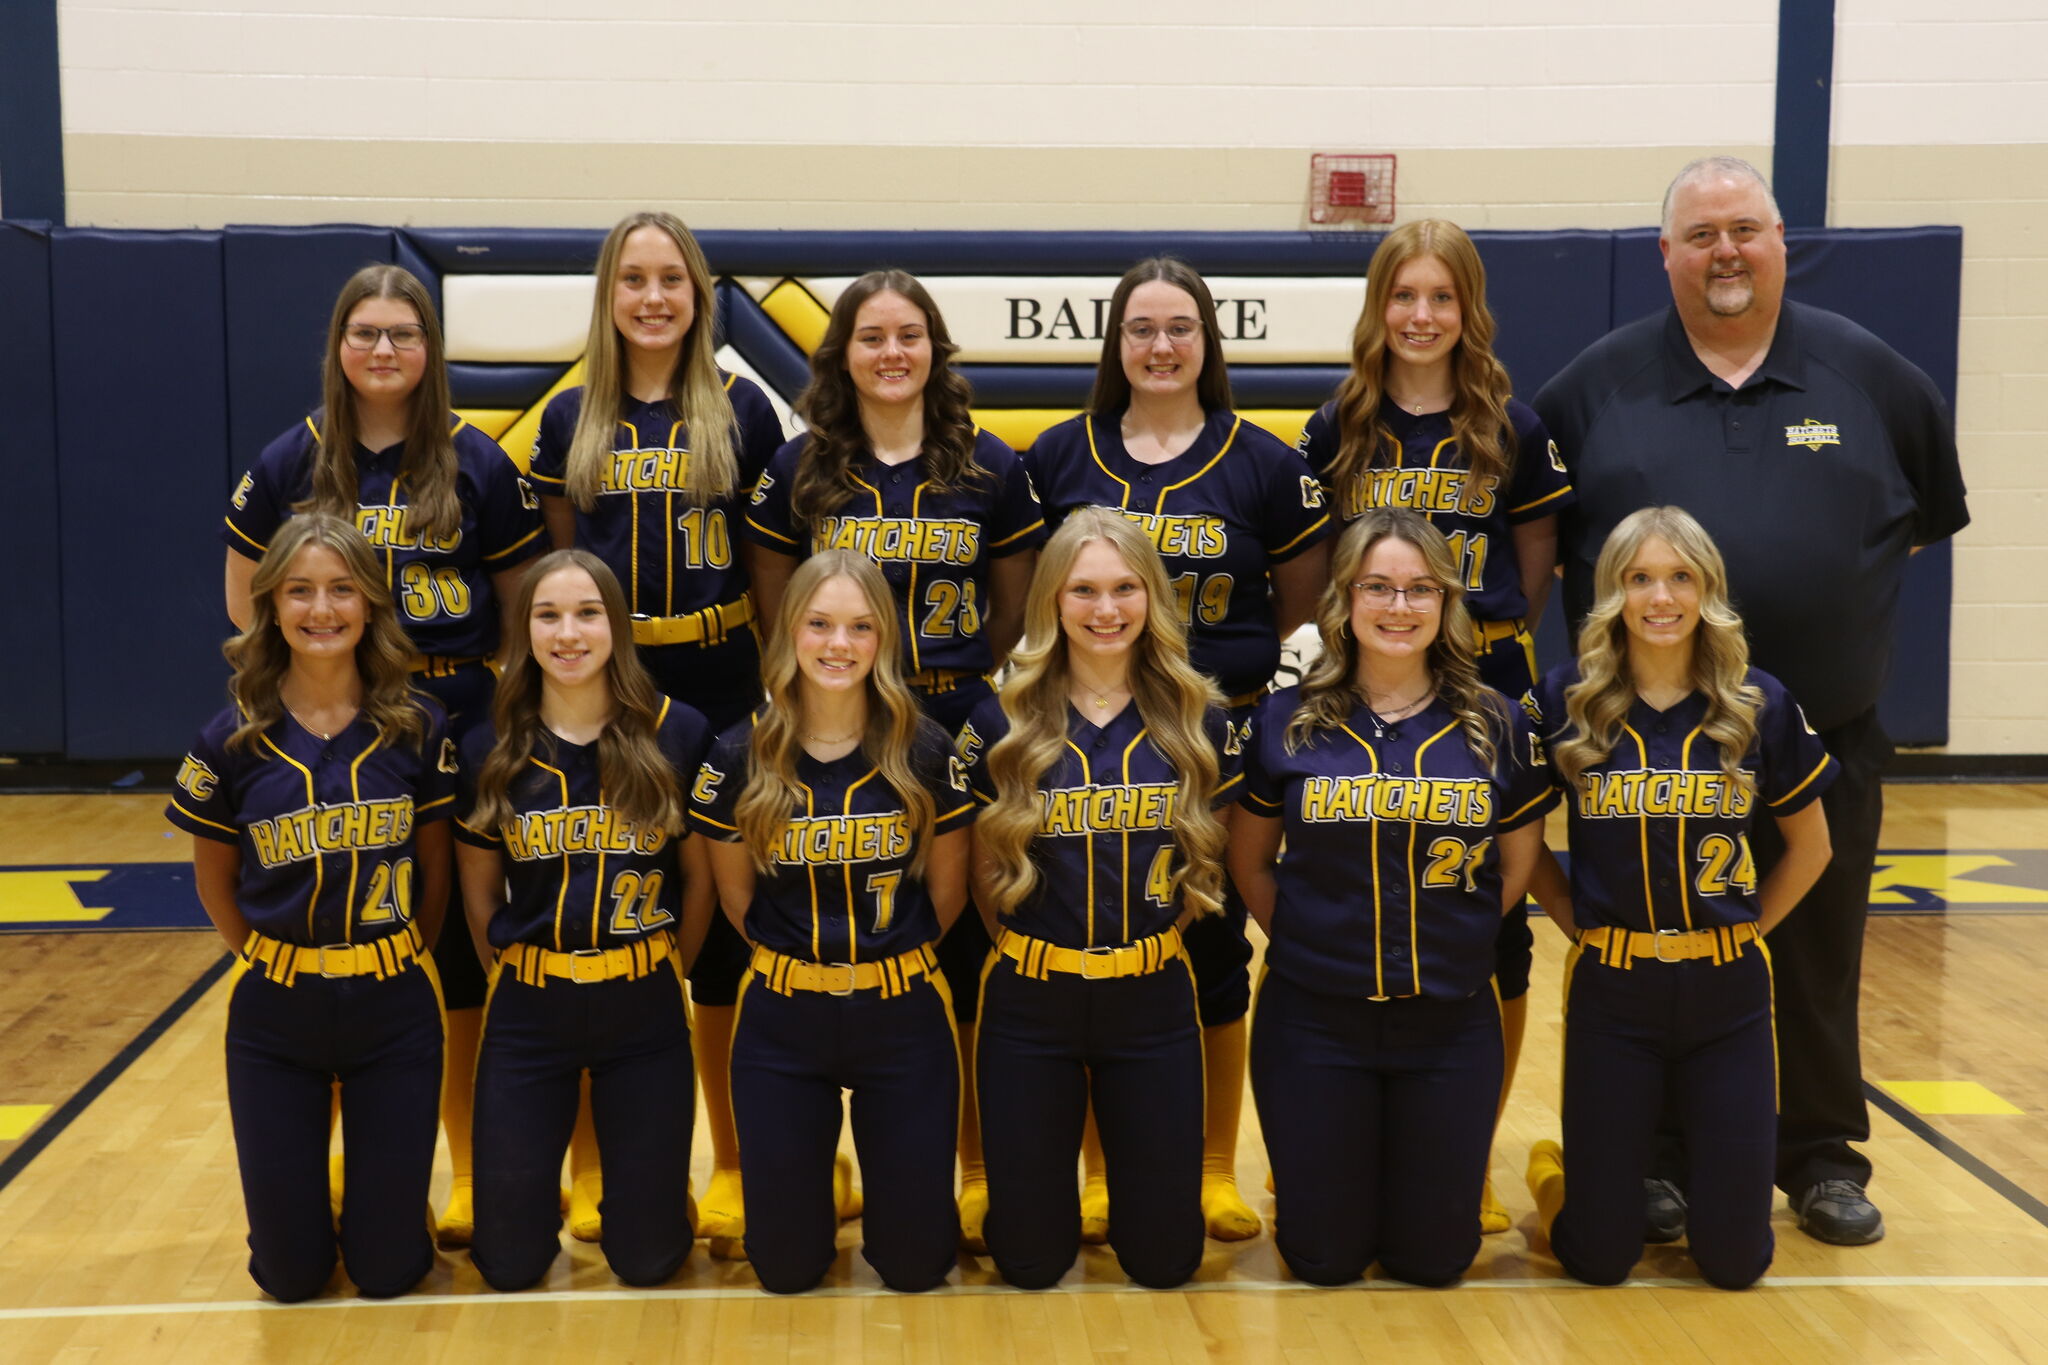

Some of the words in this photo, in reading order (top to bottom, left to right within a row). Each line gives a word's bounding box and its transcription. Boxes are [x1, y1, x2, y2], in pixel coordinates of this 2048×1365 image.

[678, 508, 731, 569] 10
[811, 516, 981, 566] HATCHETS
[401, 561, 475, 621] 30
[921, 578, 981, 637] 23
[1170, 571, 1234, 625] 19
[176, 751, 220, 802] TC
[1301, 773, 1493, 827] HATCHETS
[1577, 767, 1757, 820] HATCHETS
[248, 793, 416, 869] HATCHETS
[768, 810, 913, 865] ATCHETS
[1037, 779, 1180, 838] ATCHET
[358, 856, 413, 925] 20
[1145, 844, 1177, 908] 4
[1422, 835, 1492, 893] 21
[1694, 831, 1758, 897] 24
[610, 868, 675, 934] 22
[866, 868, 903, 933] 7
